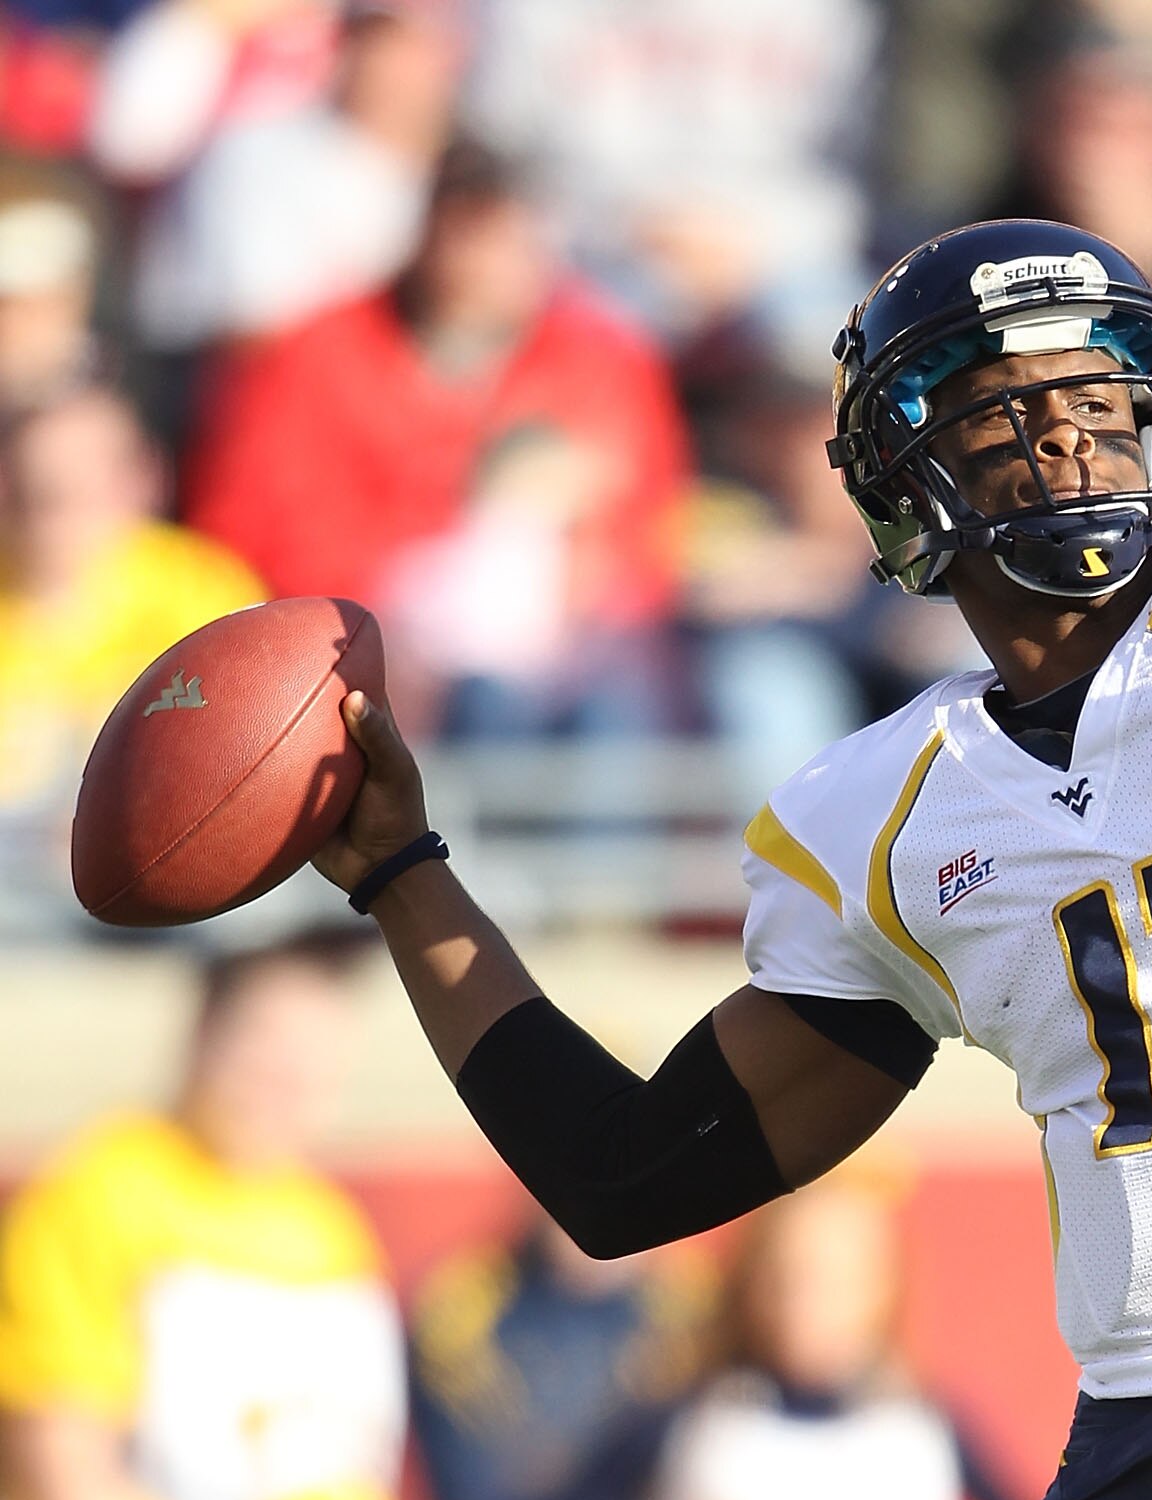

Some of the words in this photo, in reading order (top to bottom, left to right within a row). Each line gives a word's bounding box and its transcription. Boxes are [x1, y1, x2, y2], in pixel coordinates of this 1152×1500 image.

[1003, 262, 1067, 282] schutt
[938, 848, 977, 887] BIG
[939, 857, 995, 906] EAST
